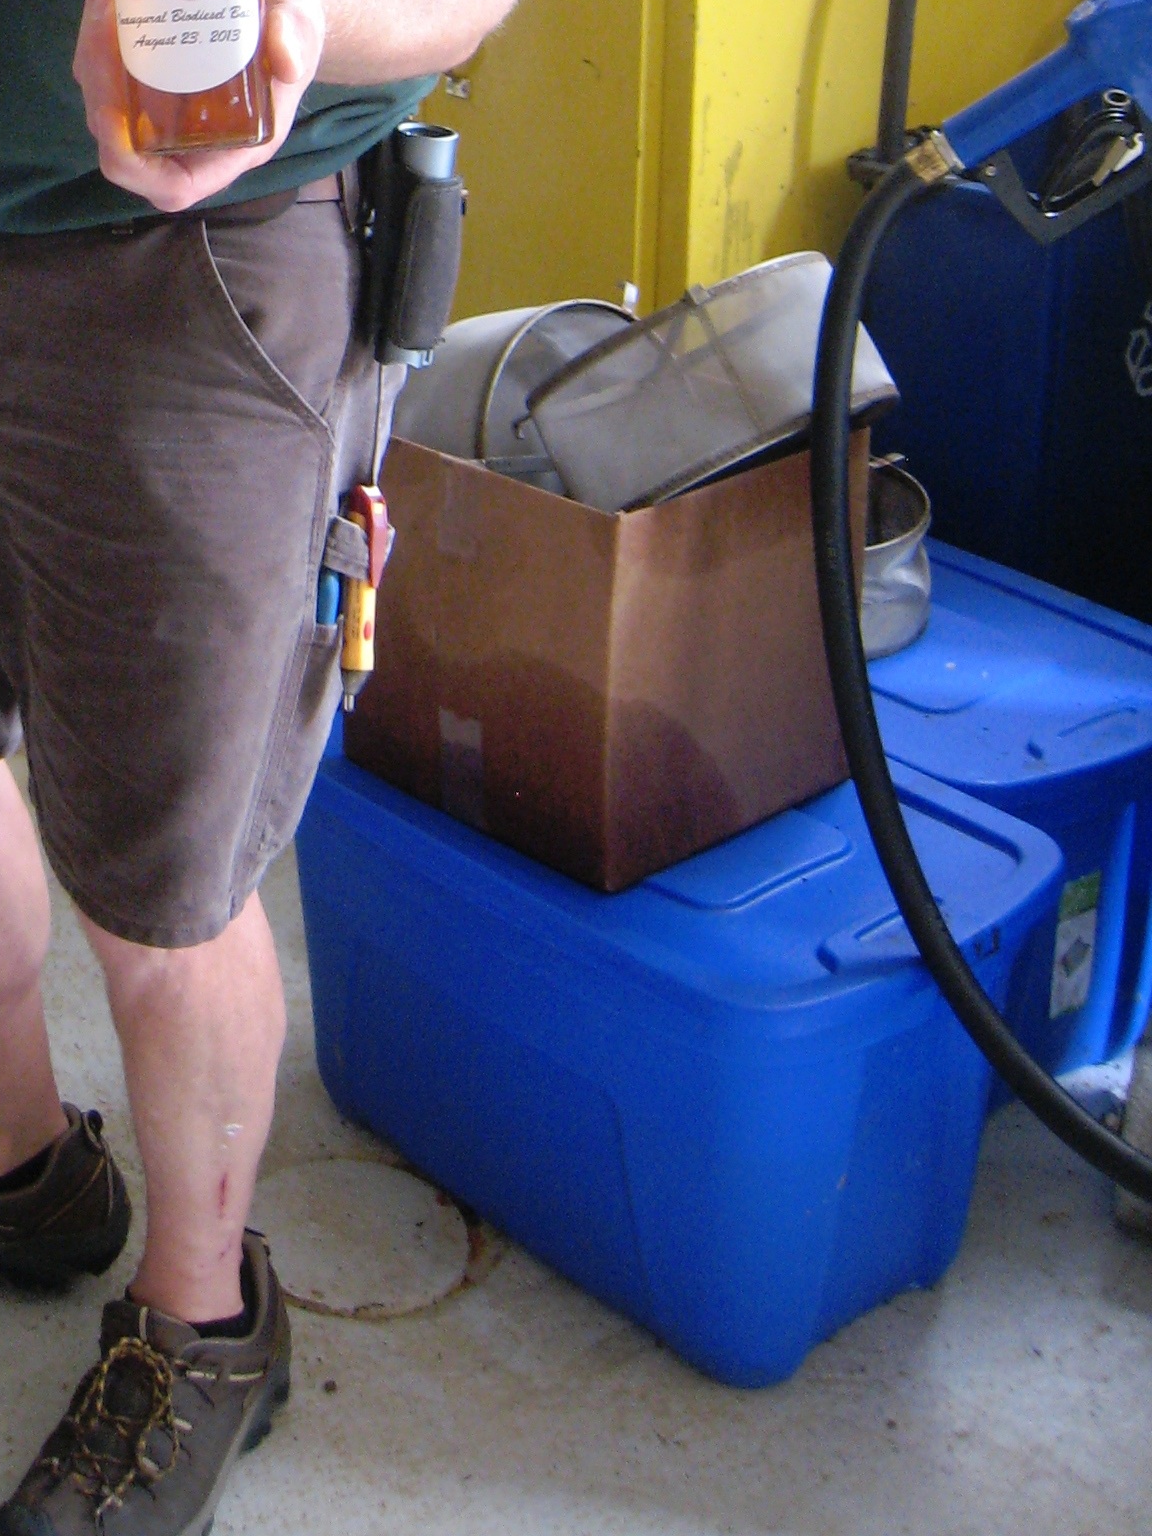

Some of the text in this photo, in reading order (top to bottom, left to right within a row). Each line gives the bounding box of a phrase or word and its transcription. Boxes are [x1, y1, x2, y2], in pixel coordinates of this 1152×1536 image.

[171, 8, 225, 23] Biodiesel
[133, 33, 177, 51] August
[209, 28, 241, 43] 2013
